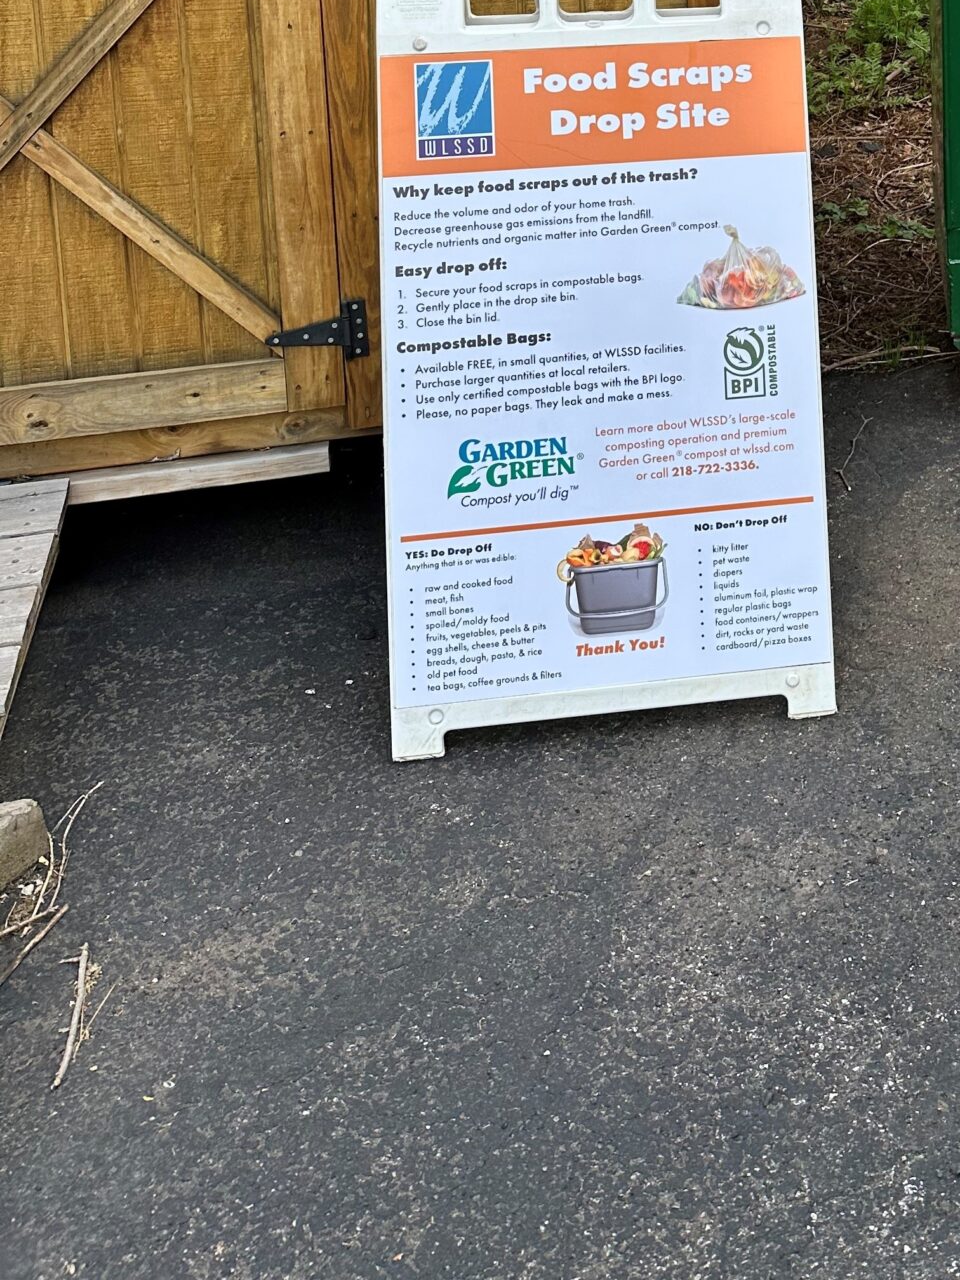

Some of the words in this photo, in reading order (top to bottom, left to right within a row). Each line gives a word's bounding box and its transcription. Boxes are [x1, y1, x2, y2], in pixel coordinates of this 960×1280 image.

[523, 62, 617, 94] Food
[628, 62, 752, 92] Scraps
[550, 109, 646, 139] Drop
[656, 100, 730, 129] Site
[424, 137, 489, 157] WLSSD
[392, 185, 430, 200] Why
[434, 183, 474, 197] keep
[477, 178, 514, 193] food
[518, 179, 568, 192] scraps
[572, 175, 598, 187] out
[601, 172, 617, 185] of
[620, 171, 645, 184] the
[648, 168, 698, 182] trash?
[394, 210, 431, 221] Reduce
[434, 208, 450, 218] the
[452, 207, 489, 217] volume
[492, 203, 511, 215] and
[514, 202, 539, 213] odor
[541, 200, 552, 212] of
[554, 203, 576, 213] your
[579, 199, 606, 209] home
[608, 196, 635, 207] trash.
[394, 226, 441, 236] Decrease
[444, 221, 503, 235] greenhouse
[506, 221, 524, 231] gas
[526, 216, 573, 227] emissions
[575, 213, 598, 223] from
[600, 212, 616, 222] the
[618, 208, 654, 221] landfill.
[394, 239, 433, 252] Recycle
[436, 237, 479, 248] nutrients
[481, 233, 501, 245] and
[504, 232, 542, 245] organic
[545, 231, 577, 240] matter
[579, 229, 598, 238] into
[600, 225, 638, 236] Garden
[395, 265, 433, 279] Easy
[436, 261, 475, 276] drop
[478, 257, 507, 271] off:
[415, 288, 450, 298] Secure
[453, 287, 476, 297] your
[479, 281, 503, 293] food
[505, 282, 537, 292] scraps
[540, 279, 549, 288] in
[551, 273, 615, 289] compostable
[396, 334, 502, 354] Compostable
[507, 333, 551, 346] Bags:
[414, 361, 464, 374] Available
[467, 358, 495, 370] FREE,
[498, 358, 507, 367] in
[510, 354, 536, 366] small
[539, 352, 589, 366] quantities,
[592, 351, 602, 359] at
[604, 346, 641, 358] WLSSD
[644, 343, 686, 355] facilities.
[767, 324, 778, 397] COMPOSTABLE
[731, 375, 759, 394] BPI
[595, 426, 624, 437] Learn
[627, 425, 653, 434] more
[656, 419, 687, 431] about
[738, 409, 795, 425] large-scale
[459, 436, 569, 475] GARDEN
[636, 473, 647, 481] or
[650, 467, 668, 479] call
[672, 459, 759, 477] 218-722-3336.
[460, 490, 512, 508] Compost
[694, 523, 713, 532] NO:
[745, 519, 769, 527] Drop
[771, 514, 787, 524] Off
[405, 550, 428, 559] YES:
[431, 549, 445, 557] Do
[447, 547, 473, 556] Drop
[475, 543, 492, 553] Off
[712, 545, 729, 554] kitty
[730, 543, 749, 551] litter
[713, 557, 726, 567] pet
[727, 555, 750, 563] waste
[443, 580, 459, 591] and
[461, 577, 492, 589] cooked
[493, 575, 513, 585] food
[713, 569, 743, 578] diapers
[713, 579, 740, 591] liquids
[425, 596, 448, 605] meat,
[450, 593, 464, 602] fish
[425, 607, 447, 618] small
[449, 606, 474, 615] bones
[426, 647, 443, 656] egg
[445, 642, 469, 653] shells,
[471, 641, 500, 650] cheese
[501, 638, 508, 647] &
[510, 637, 535, 646] butter
[576, 640, 624, 657] Thank
[629, 636, 665, 651] You!
[427, 669, 441, 679] old
[443, 669, 456, 680] pet
[458, 665, 478, 676] food
